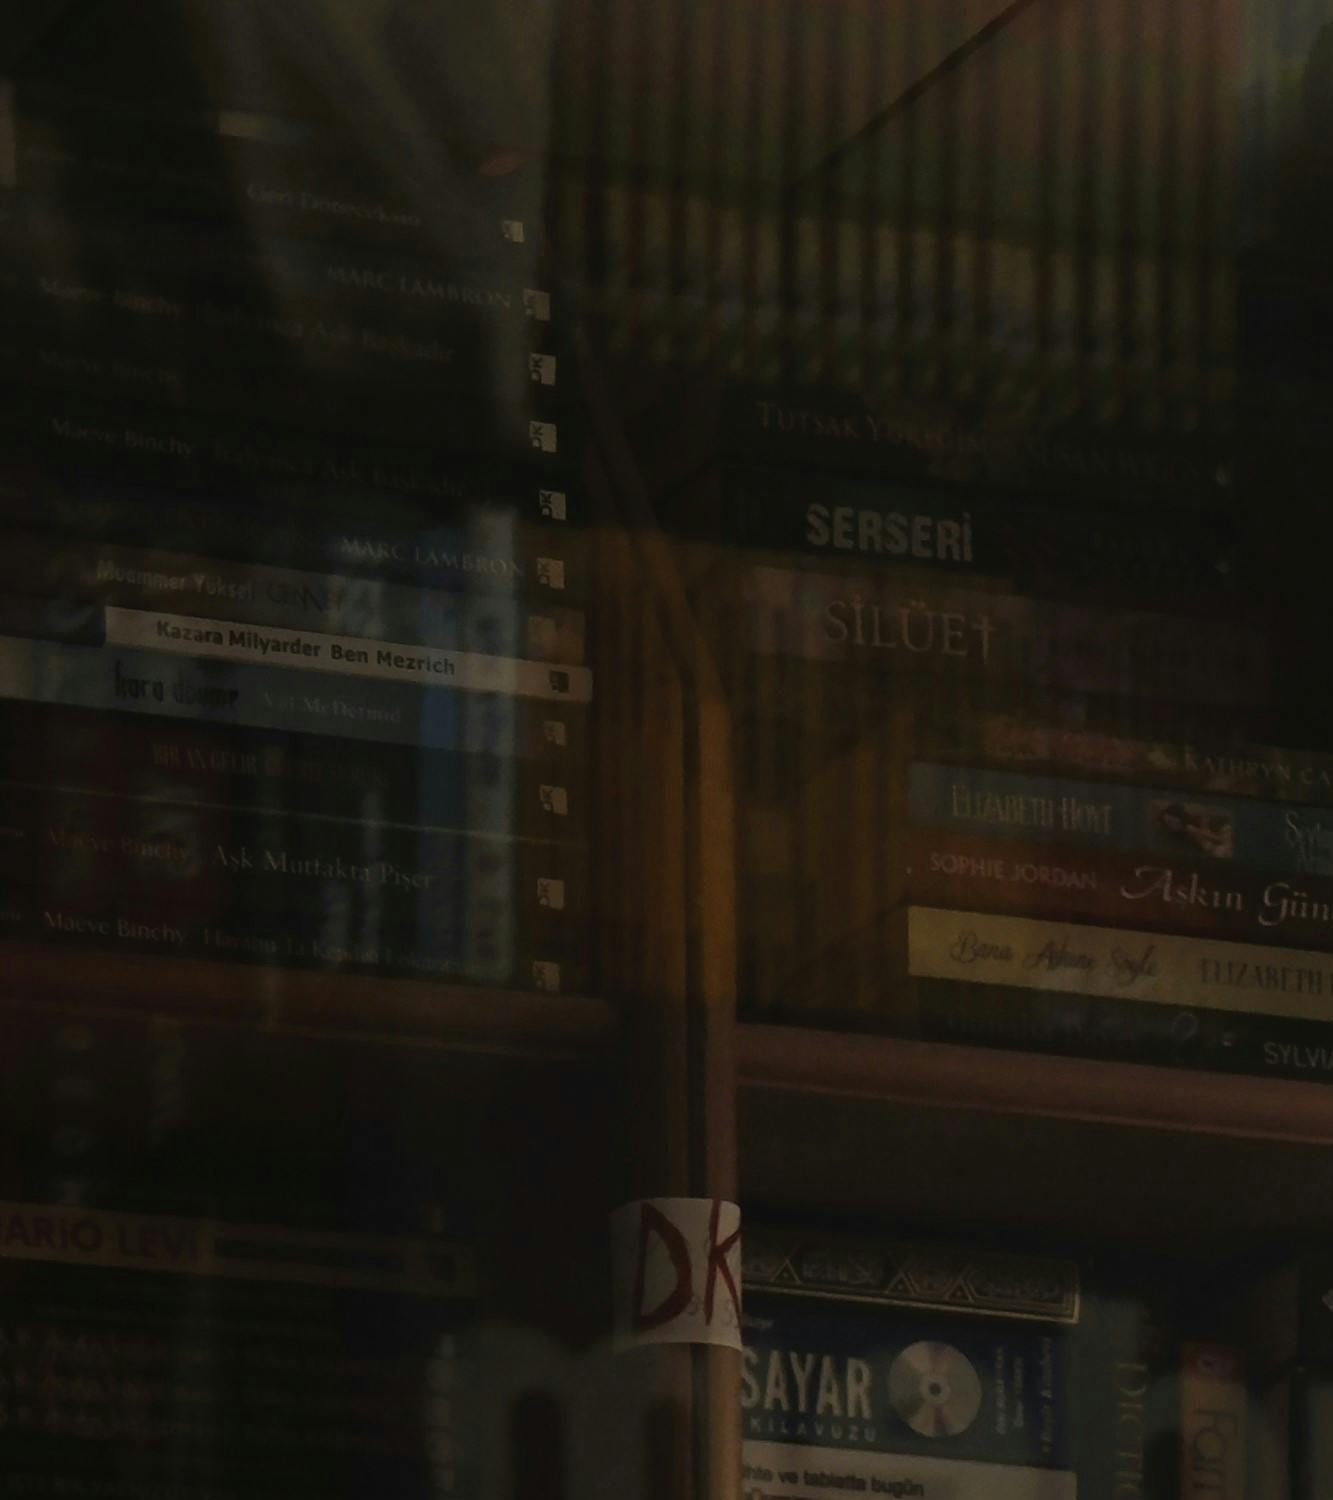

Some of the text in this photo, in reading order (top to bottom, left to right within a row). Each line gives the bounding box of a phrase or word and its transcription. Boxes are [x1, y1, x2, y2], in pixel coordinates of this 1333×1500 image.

[805, 503, 974, 564] SERSERİ
[157, 620, 456, 676] Kazara Milyarder Ben Mezrich
[210, 843, 255, 873] Aşk
[929, 850, 1006, 884] SOPHIE
[1120, 864, 1244, 914] Aşkın
[633, 1200, 742, 1331] DK
